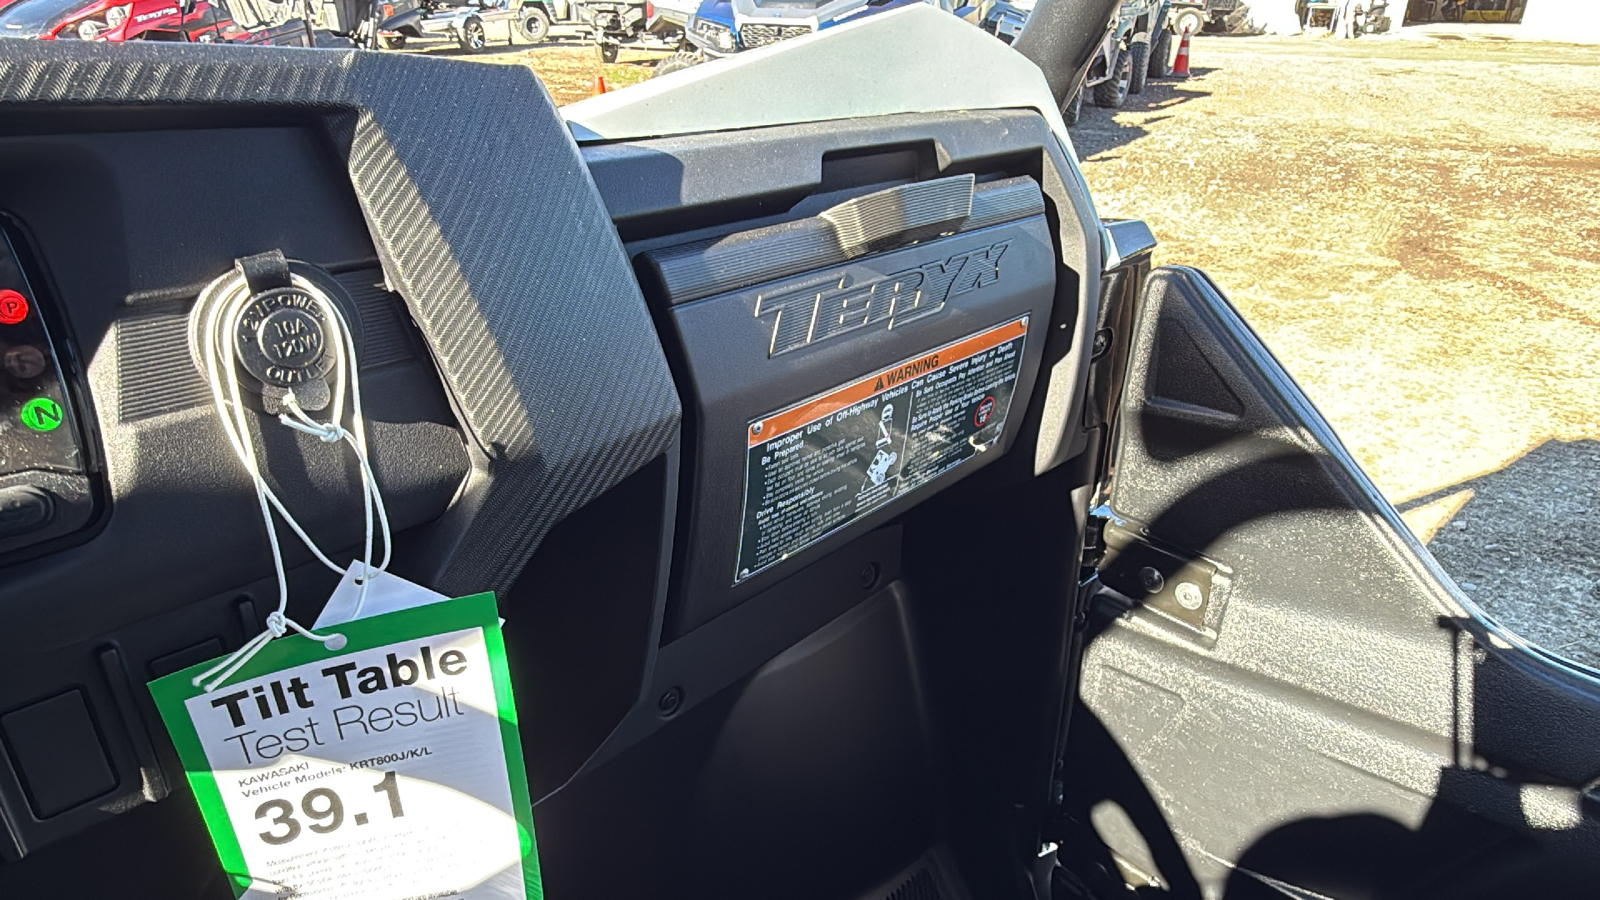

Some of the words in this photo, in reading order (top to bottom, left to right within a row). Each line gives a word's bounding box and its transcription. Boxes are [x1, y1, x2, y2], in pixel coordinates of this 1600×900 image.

[6, 301, 18, 314] P
[755, 238, 1015, 359] TERYX
[274, 318, 309, 338] 10A
[273, 333, 318, 359] 120W
[887, 354, 939, 386] WARNING
[34, 402, 61, 425] N
[766, 430, 803, 453] Improper
[807, 422, 822, 435] Use
[825, 416, 834, 427] of
[837, 398, 879, 421] Off-Highway
[881, 385, 908, 402] Vehicles
[911, 379, 924, 390] Can
[926, 370, 946, 383] Cause
[948, 361, 969, 374] Severe
[761, 456, 771, 466] Be
[774, 440, 805, 460] Prepared
[210, 676, 315, 728] Tilt
[321, 646, 468, 700] Table
[223, 717, 325, 765] Test
[333, 686, 465, 740] Result
[238, 762, 309, 788] KAWASAKI
[241, 780, 291, 798] Vehicle
[295, 765, 346, 784] Models:
[349, 746, 433, 771] KRT800J/K/L
[254, 770, 404, 845] 39.1
